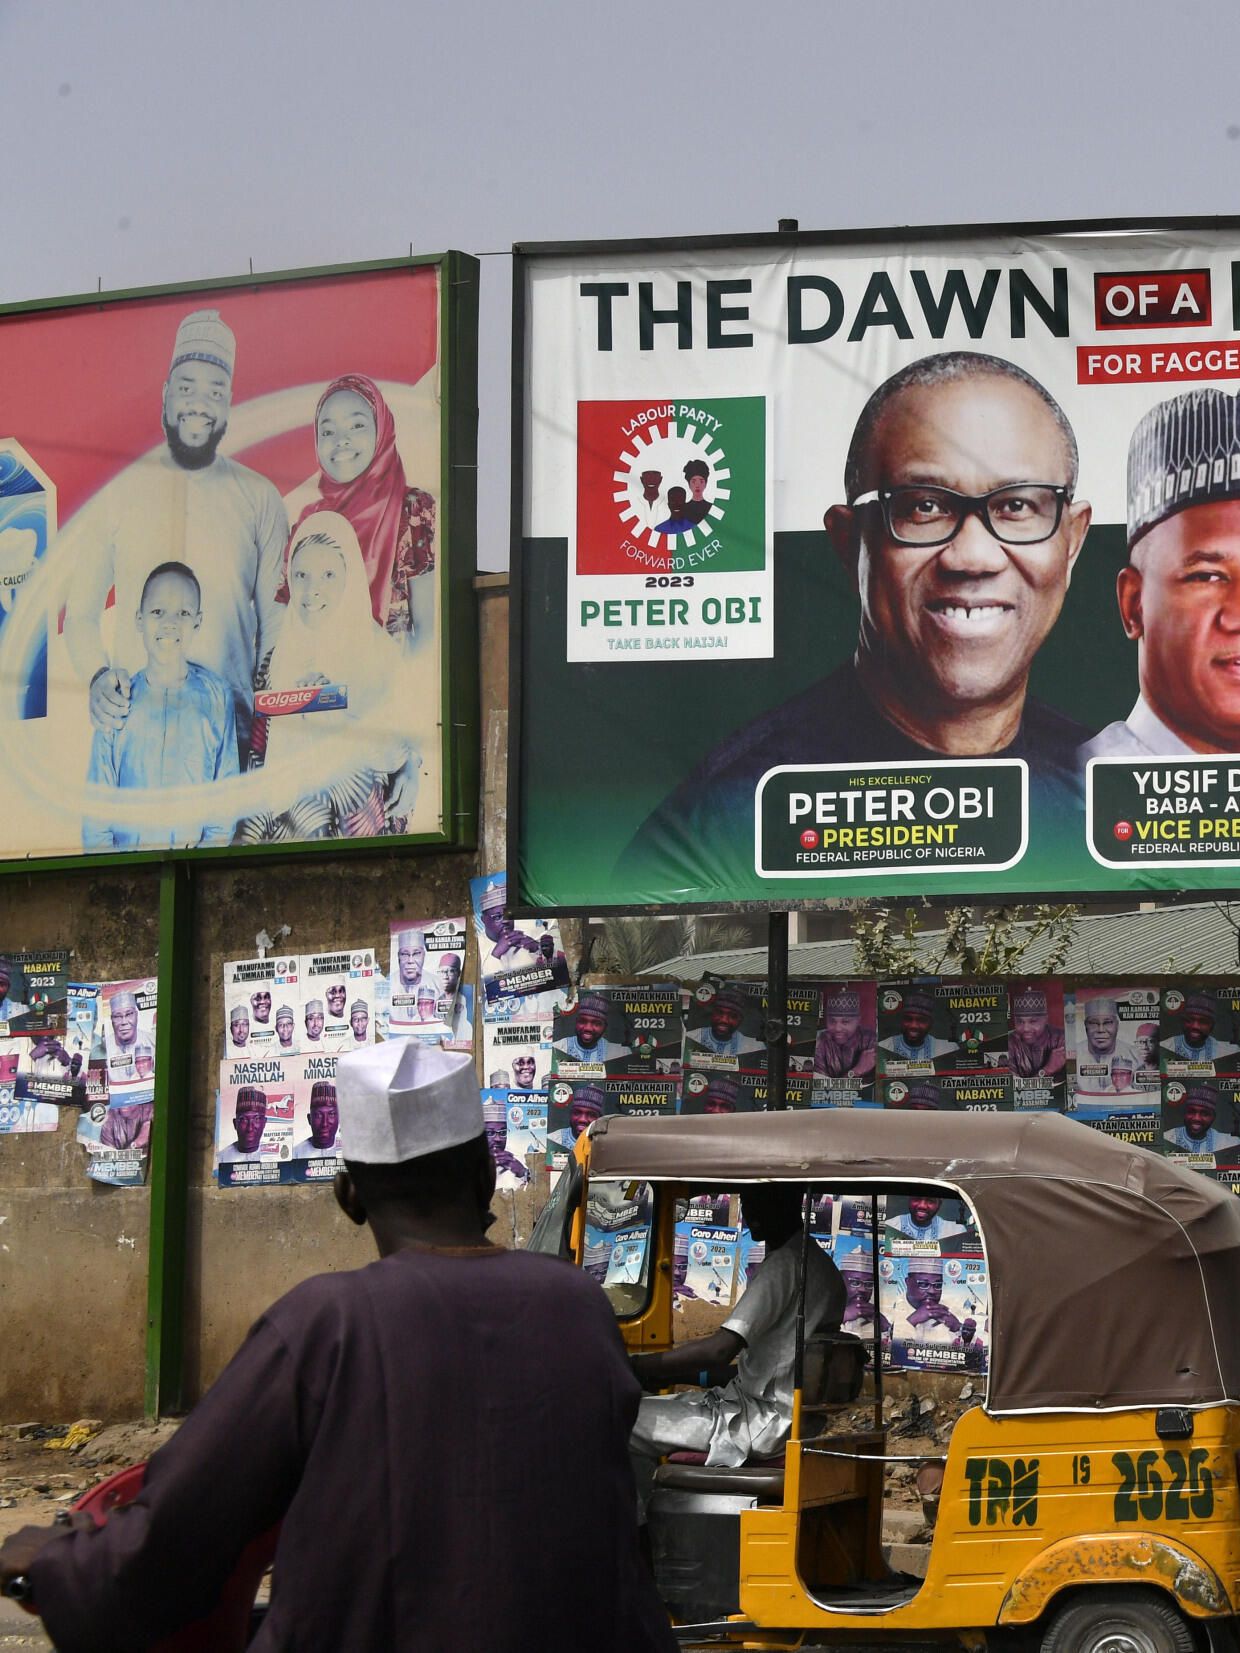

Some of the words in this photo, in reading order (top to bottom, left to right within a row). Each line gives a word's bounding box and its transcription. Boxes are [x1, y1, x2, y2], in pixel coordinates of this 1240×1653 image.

[580, 279, 753, 351] THE
[788, 268, 1069, 344] DAWN
[1105, 284, 1158, 316] OF
[1171, 281, 1200, 315] A
[1088, 352, 1141, 376] FOR
[1150, 348, 1240, 374] FAGGE
[621, 405, 677, 437] LABOUR
[679, 405, 723, 431] PARTY
[619, 540, 684, 570] FORWARD
[688, 539, 723, 567] EVER
[645, 575, 695, 589] 2023
[580, 599, 689, 627] PETER
[702, 597, 762, 624] OBI
[607, 638, 641, 651] TAKE
[645, 637, 679, 650] BACK
[683, 635, 728, 649] NAIJA!
[258, 691, 313, 707] Colgate
[849, 778, 867, 787] HIS
[869, 775, 932, 787] EXCELLENCY
[1133, 770, 1218, 795] YUSIF
[789, 789, 916, 825] PETER
[924, 787, 995, 820] OBI
[1146, 796, 1203, 815] BABA
[823, 825, 958, 848] PRESIDENT
[1135, 820, 1192, 840] VICE
[795, 851, 849, 864] FEDERAL
[853, 849, 912, 862] REPUBLIC
[915, 848, 931, 859] OF
[934, 846, 985, 859] NIGERIA
[1131, 843, 1185, 854] FEDERAL
[24, 962, 61, 974] NABAYYE
[30, 977, 55, 987] 2023
[506, 969, 553, 985] MEMBER
[625, 1003, 672, 1013] NABAYYE
[950, 997, 997, 1008] NABAYYE
[634, 1018, 665, 1028] 2023
[960, 1012, 990, 1023] 2023
[498, 1026, 541, 1035] MANUFARMU
[234, 1062, 280, 1074] NASRUN
[230, 1072, 285, 1085] MINALLAH
[33, 1082, 73, 1093] MEMBER
[508, 1093, 526, 1103] Goro
[620, 1095, 667, 1104] NABAYYE
[956, 1089, 1003, 1100] NABAYYE
[691, 1228, 711, 1239] Goro
[712, 1231, 737, 1242] Alheri
[915, 1350, 966, 1361] MEMBER
